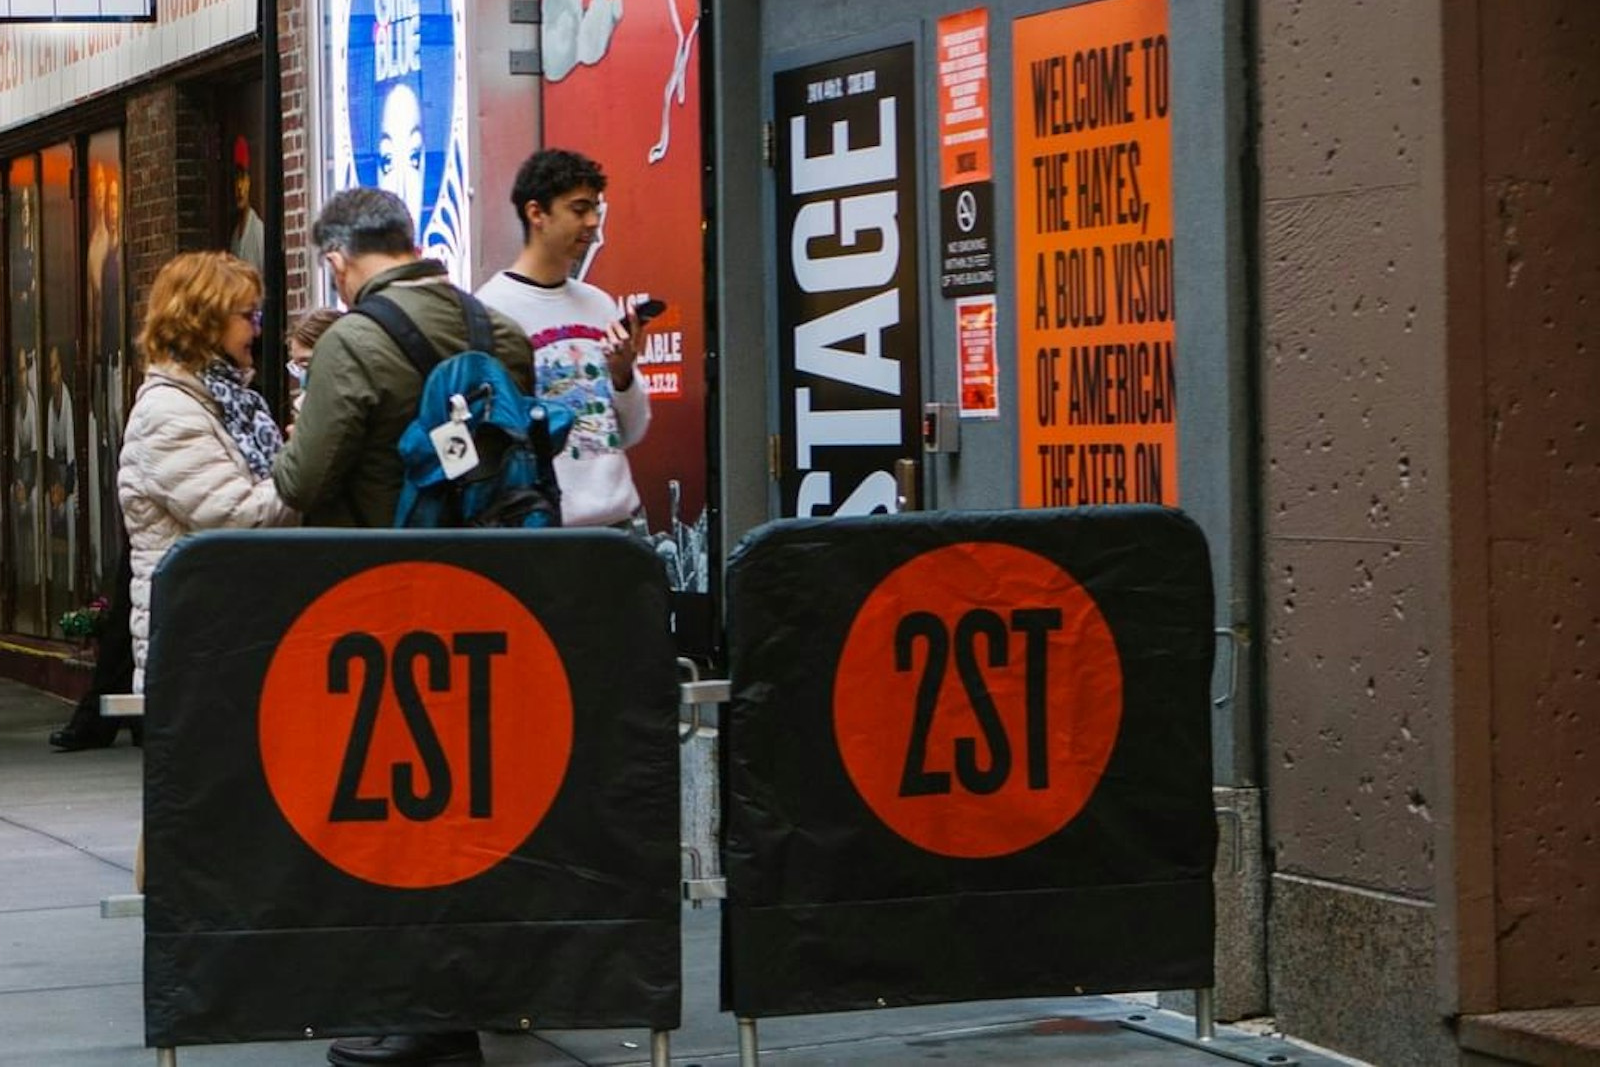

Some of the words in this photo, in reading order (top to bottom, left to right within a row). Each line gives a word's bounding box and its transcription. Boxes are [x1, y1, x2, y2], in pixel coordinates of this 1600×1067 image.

[374, 14, 422, 83] BLUE
[1031, 40, 1136, 139] WELCOME
[1141, 33, 1170, 121] TO
[1035, 150, 1071, 236] THE
[1076, 139, 1150, 235] HAYES,
[1035, 253, 1049, 331] A
[1054, 239, 1108, 329] BOLD
[1036, 346, 1064, 428] OF
[1038, 442, 1131, 509] THEATER
[1134, 441, 1164, 507] ON
[326, 630, 508, 824] 2ST
[894, 608, 1063, 799] 2ST
